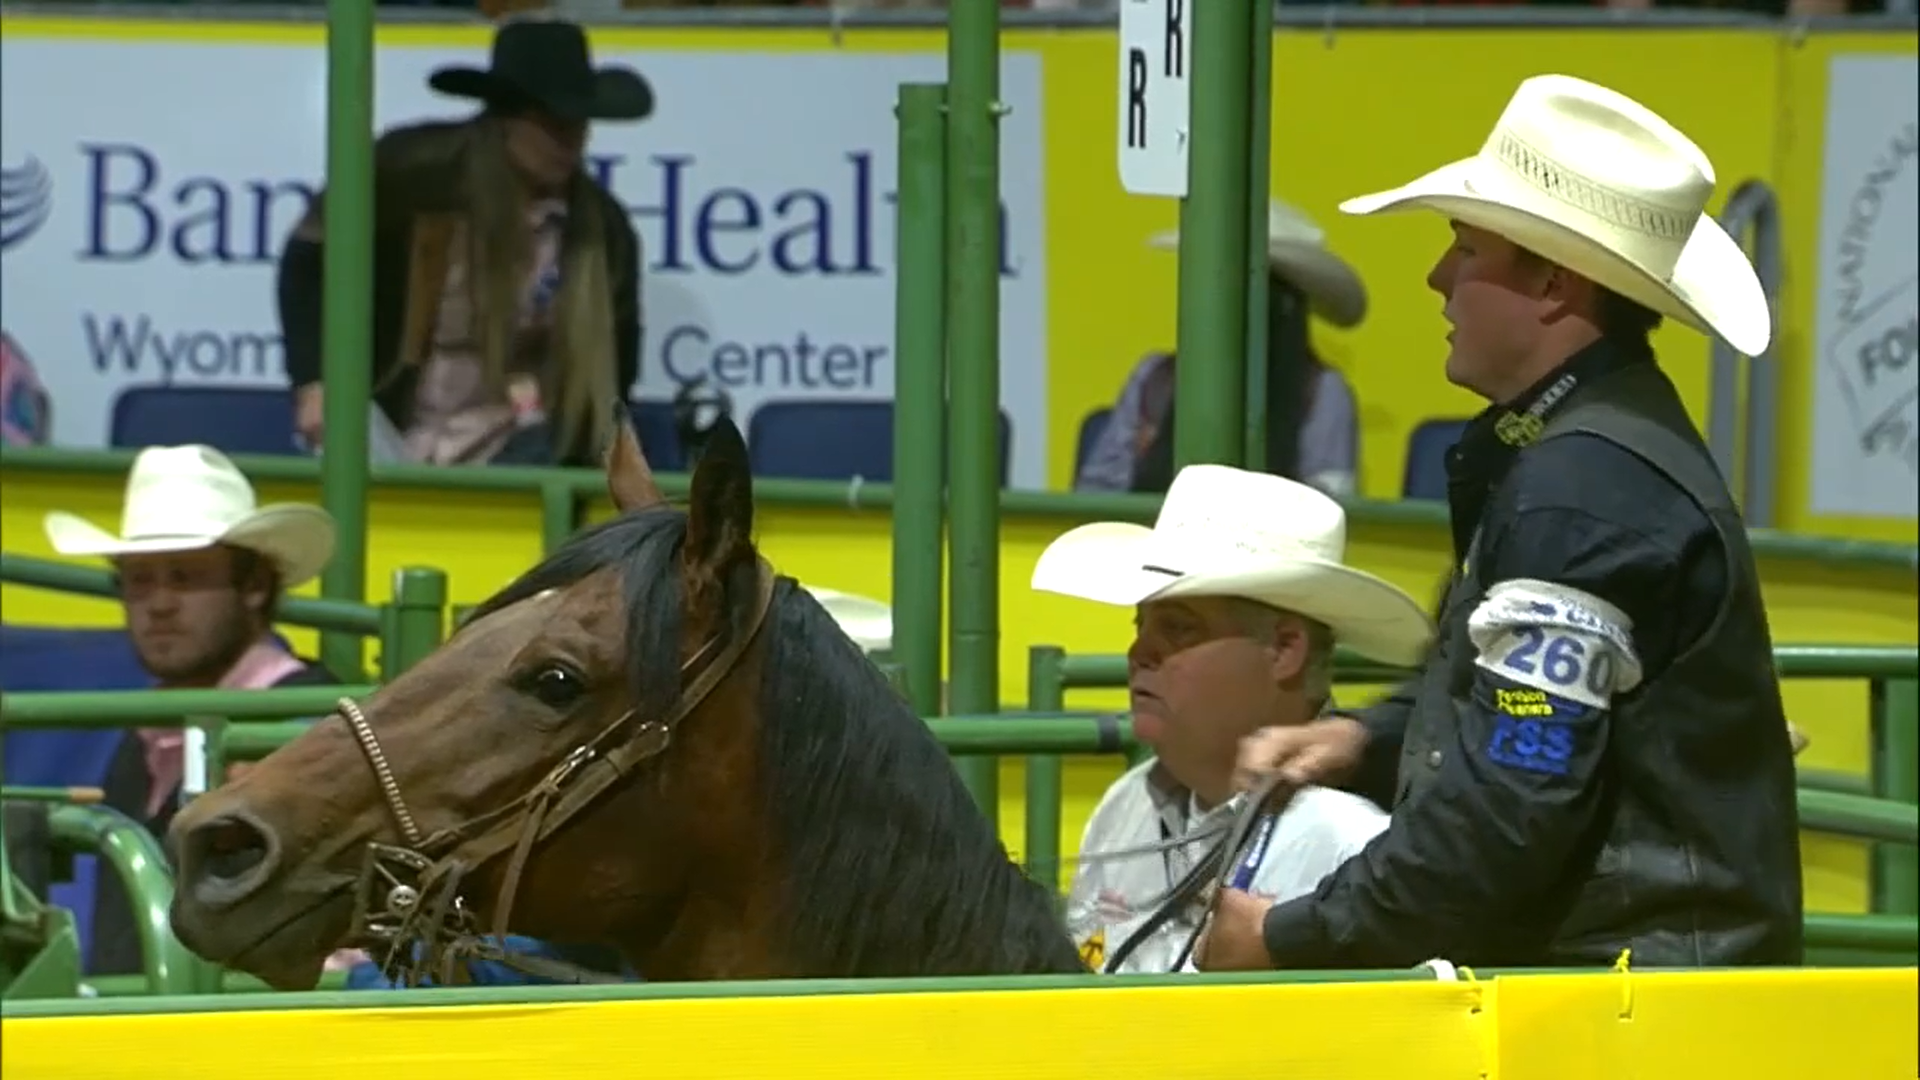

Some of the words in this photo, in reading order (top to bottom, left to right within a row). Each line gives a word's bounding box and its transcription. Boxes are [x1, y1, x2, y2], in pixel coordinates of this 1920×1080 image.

[1128, 46, 1148, 149] R
[78, 142, 315, 265] Ban
[586, 150, 1020, 279] Heal
[82, 311, 286, 387] Wyom
[660, 323, 890, 391] Center
[1503, 626, 1615, 697] 260
